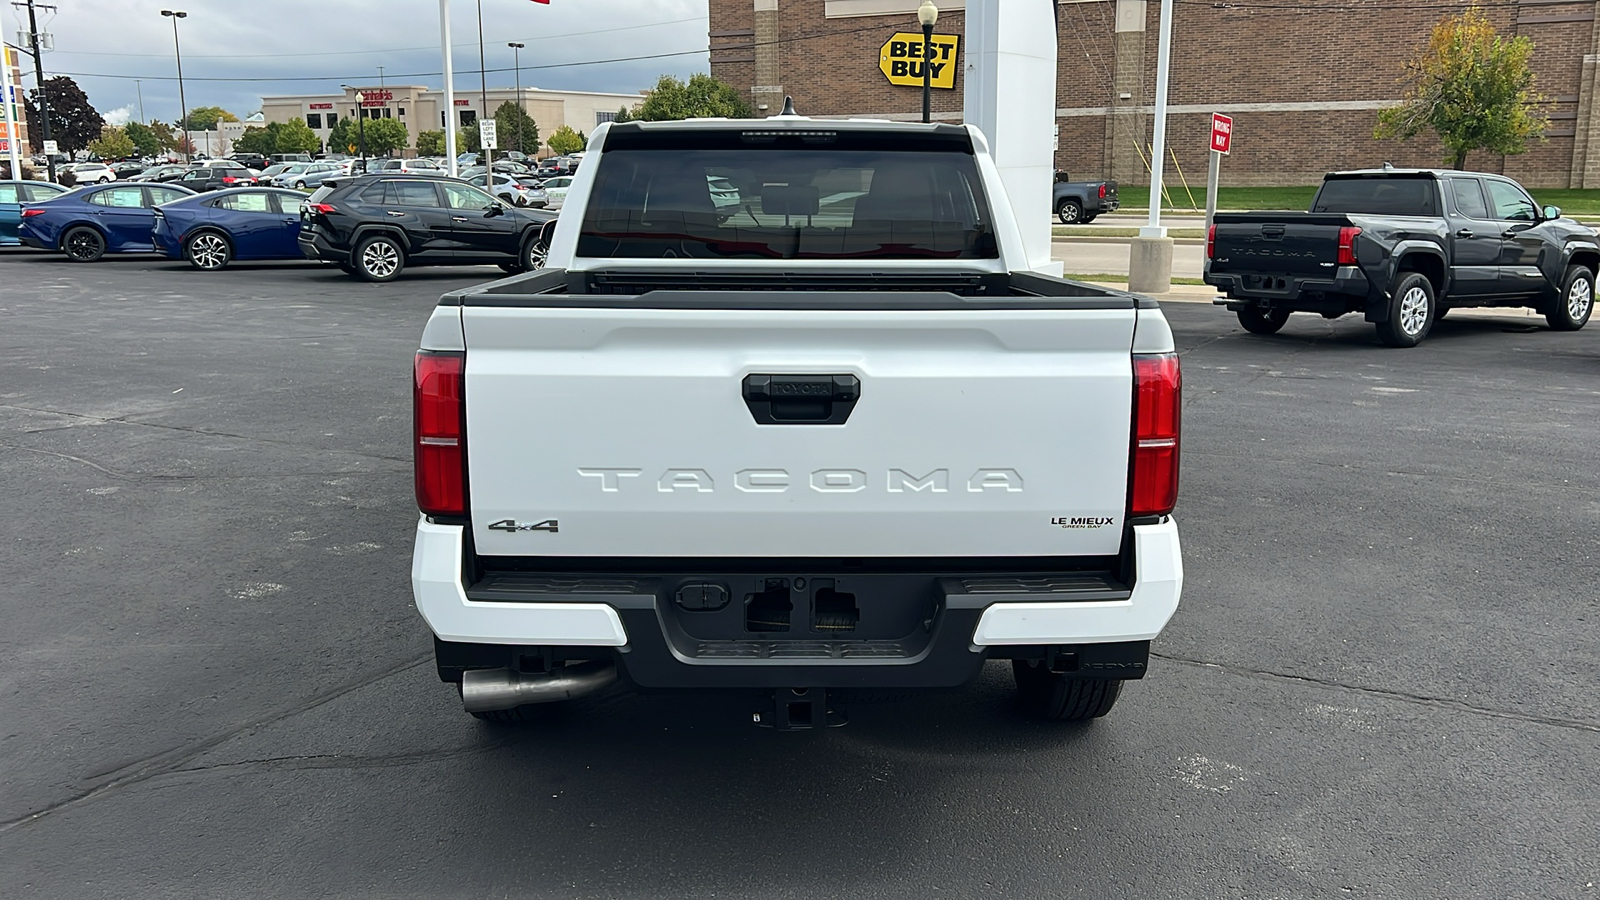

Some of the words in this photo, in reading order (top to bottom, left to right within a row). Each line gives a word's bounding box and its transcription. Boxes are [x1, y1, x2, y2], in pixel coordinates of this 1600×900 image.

[890, 41, 954, 60] BEST
[891, 60, 946, 79] BUY
[1214, 119, 1230, 134] WRONG
[1215, 134, 1227, 147] WAY
[1231, 248, 1316, 257] TACOMA
[774, 383, 829, 394] TOYOTA
[577, 467, 1024, 492] TACOMA
[1051, 517, 1067, 525] LE
[1070, 517, 1114, 525] MIEUX
[1081, 662, 1144, 671] ACOMA
